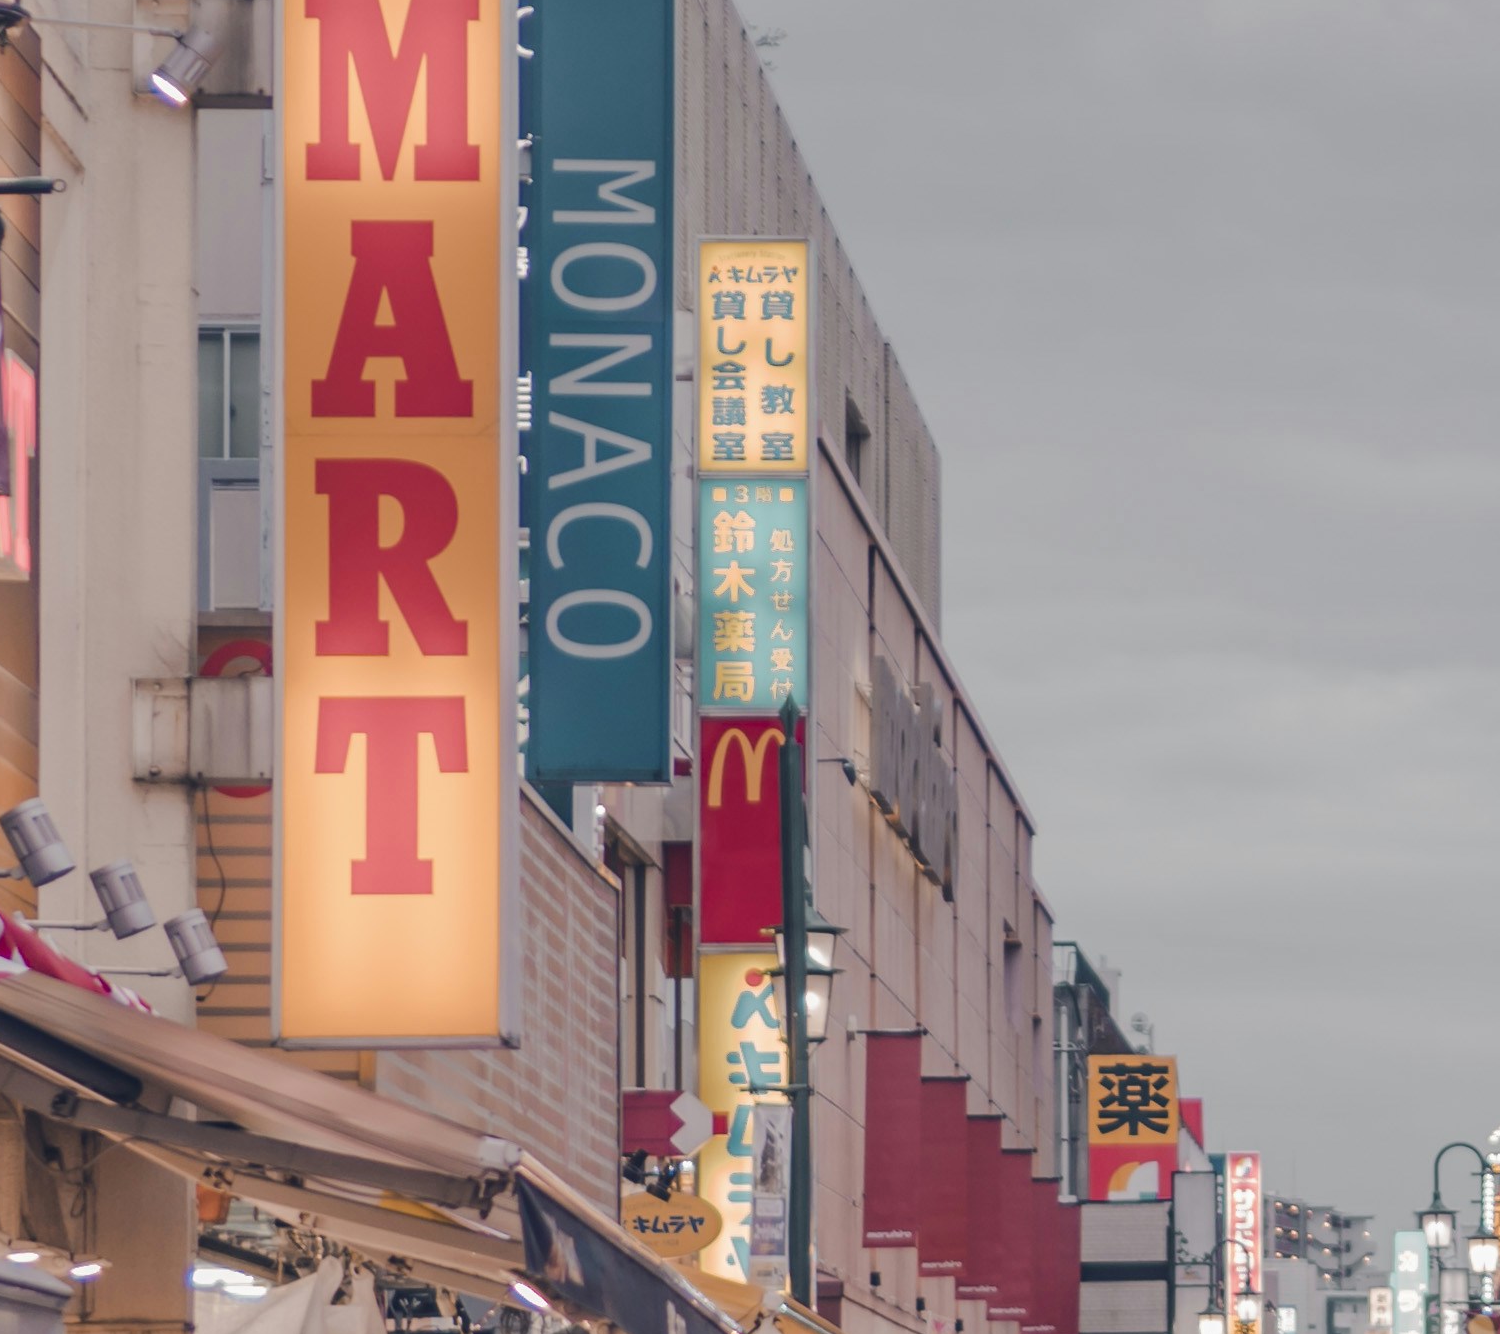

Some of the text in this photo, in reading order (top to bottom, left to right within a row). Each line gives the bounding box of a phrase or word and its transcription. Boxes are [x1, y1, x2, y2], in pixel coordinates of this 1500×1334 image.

[544, 157, 658, 660] MONACO
[711, 289, 747, 461] 貸し会議室
[760, 289, 796, 461] 貸し教室
[712, 510, 757, 703] 鈴木薬局
[769, 528, 794, 700] 処方せん受付
[1097, 1062, 1171, 1137] 薬
